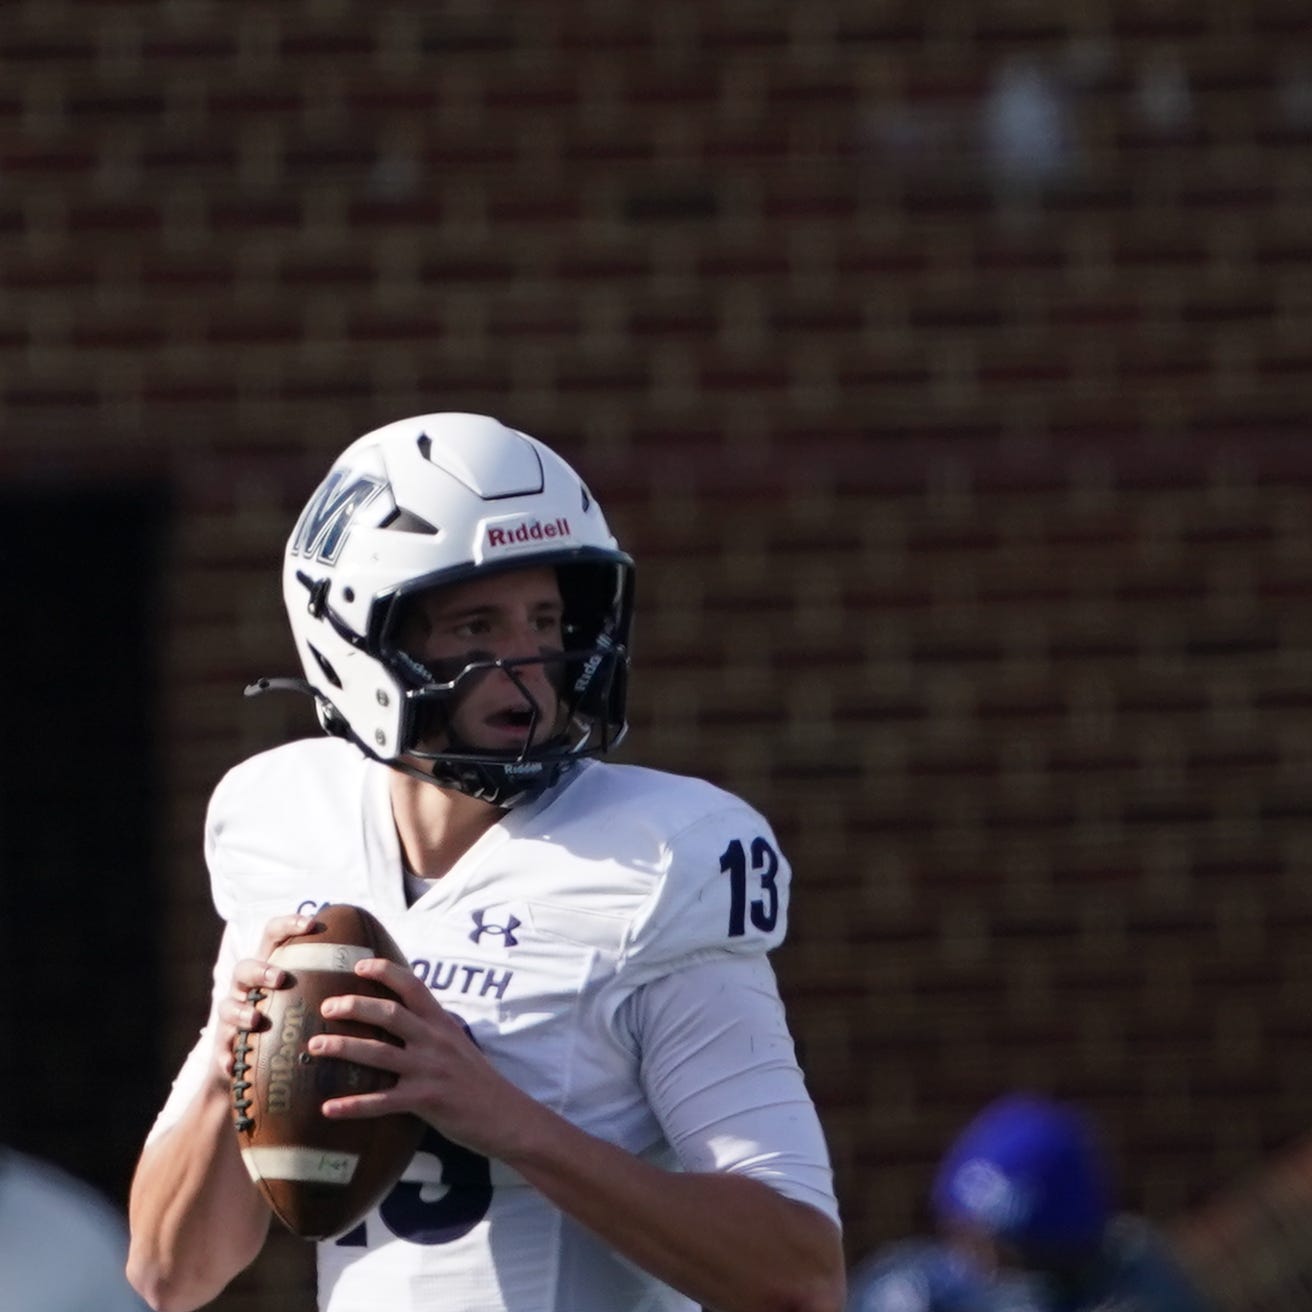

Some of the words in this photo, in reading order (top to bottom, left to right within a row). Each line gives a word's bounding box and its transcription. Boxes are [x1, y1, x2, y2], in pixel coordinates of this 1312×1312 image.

[290, 468, 388, 566] M
[488, 518, 571, 548] Riddell
[719, 836, 778, 937] 13
[411, 958, 514, 1000] OUTH
[336, 1010, 494, 1246] 3
